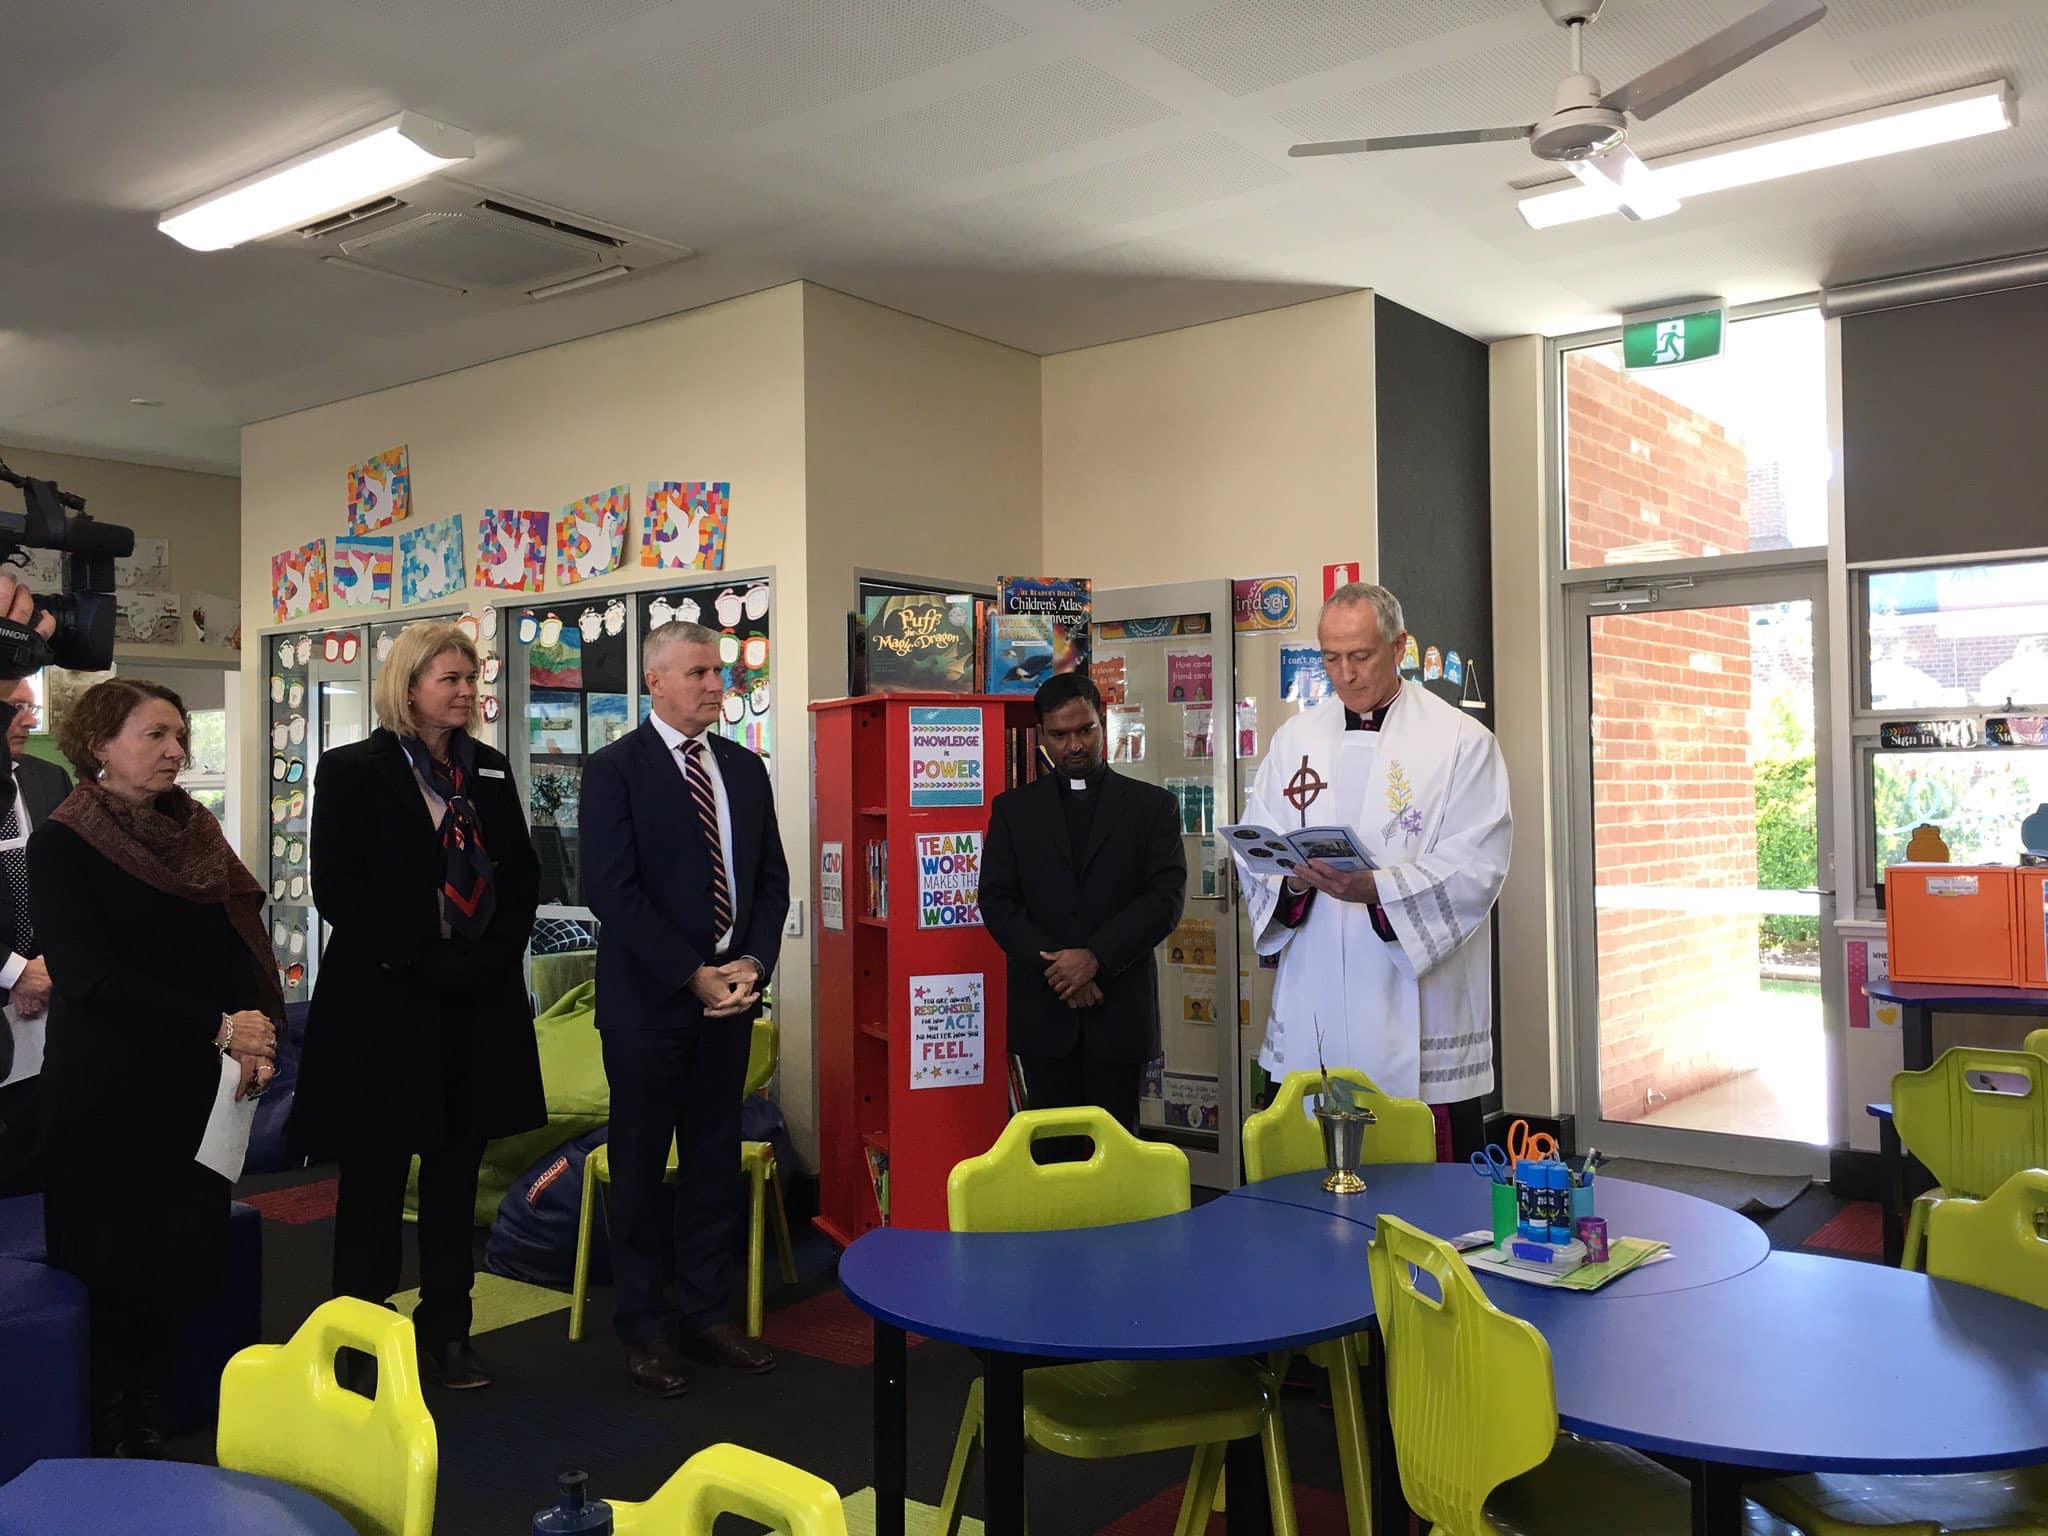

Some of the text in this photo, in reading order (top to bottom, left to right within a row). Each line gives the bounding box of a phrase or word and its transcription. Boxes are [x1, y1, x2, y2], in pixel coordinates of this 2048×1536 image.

[1010, 597, 1082, 611] Children's Atlas
[1235, 592, 1289, 612] indset
[873, 632, 959, 656] Magic Dragon
[1288, 655, 1307, 664] can't
[1309, 656, 1323, 665] ma
[913, 735, 979, 747] KNOWLEDGE
[1890, 735, 1917, 747] Sign
[912, 759, 981, 779] POWER
[921, 854, 978, 875] WORK
[923, 872, 979, 890] MAKES THE
[922, 888, 979, 907] DREAM
[922, 904, 980, 926] WORK
[1872, 951, 1889, 959] WHE
[914, 1002, 980, 1016] RESPONSIBLE
